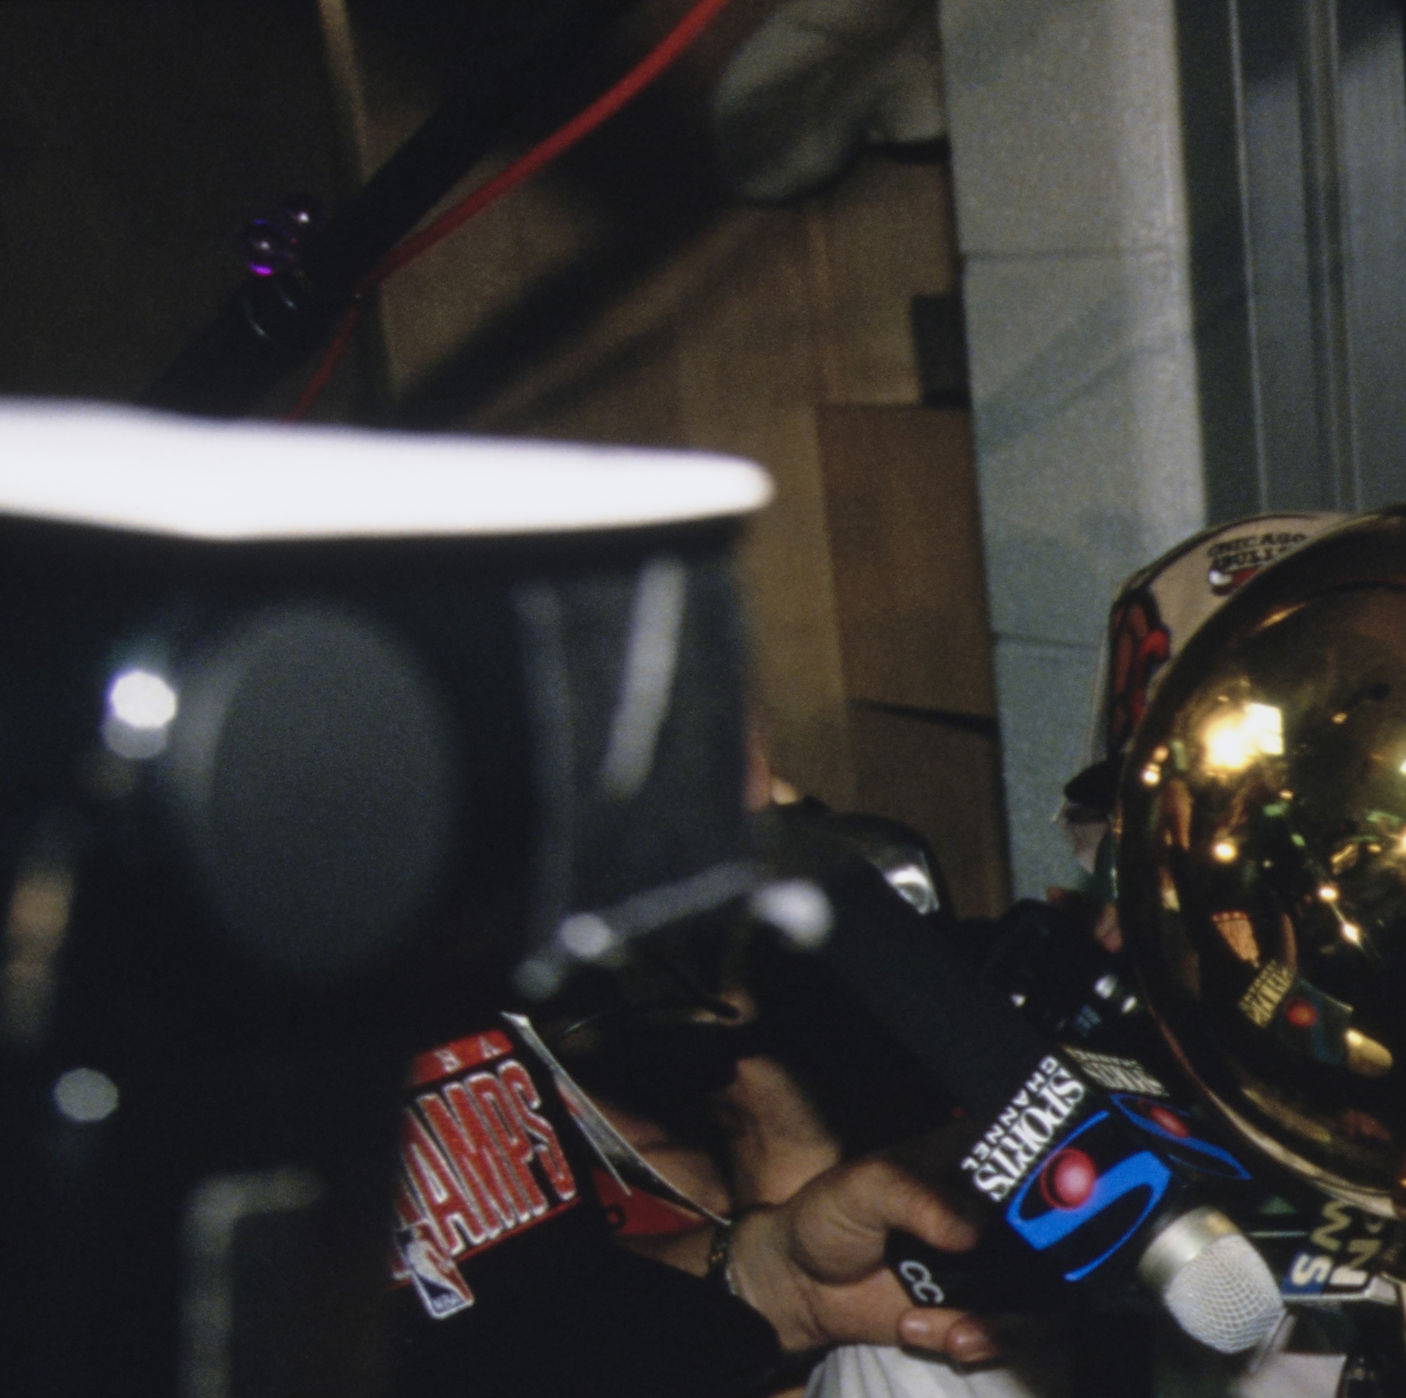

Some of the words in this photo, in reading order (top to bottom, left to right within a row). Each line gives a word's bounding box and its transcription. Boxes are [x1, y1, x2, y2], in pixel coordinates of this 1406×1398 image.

[396, 1059, 577, 1262] AMPS
[960, 1055, 1059, 1171] CHANNEL
[973, 1066, 1086, 1203] SPORTS
